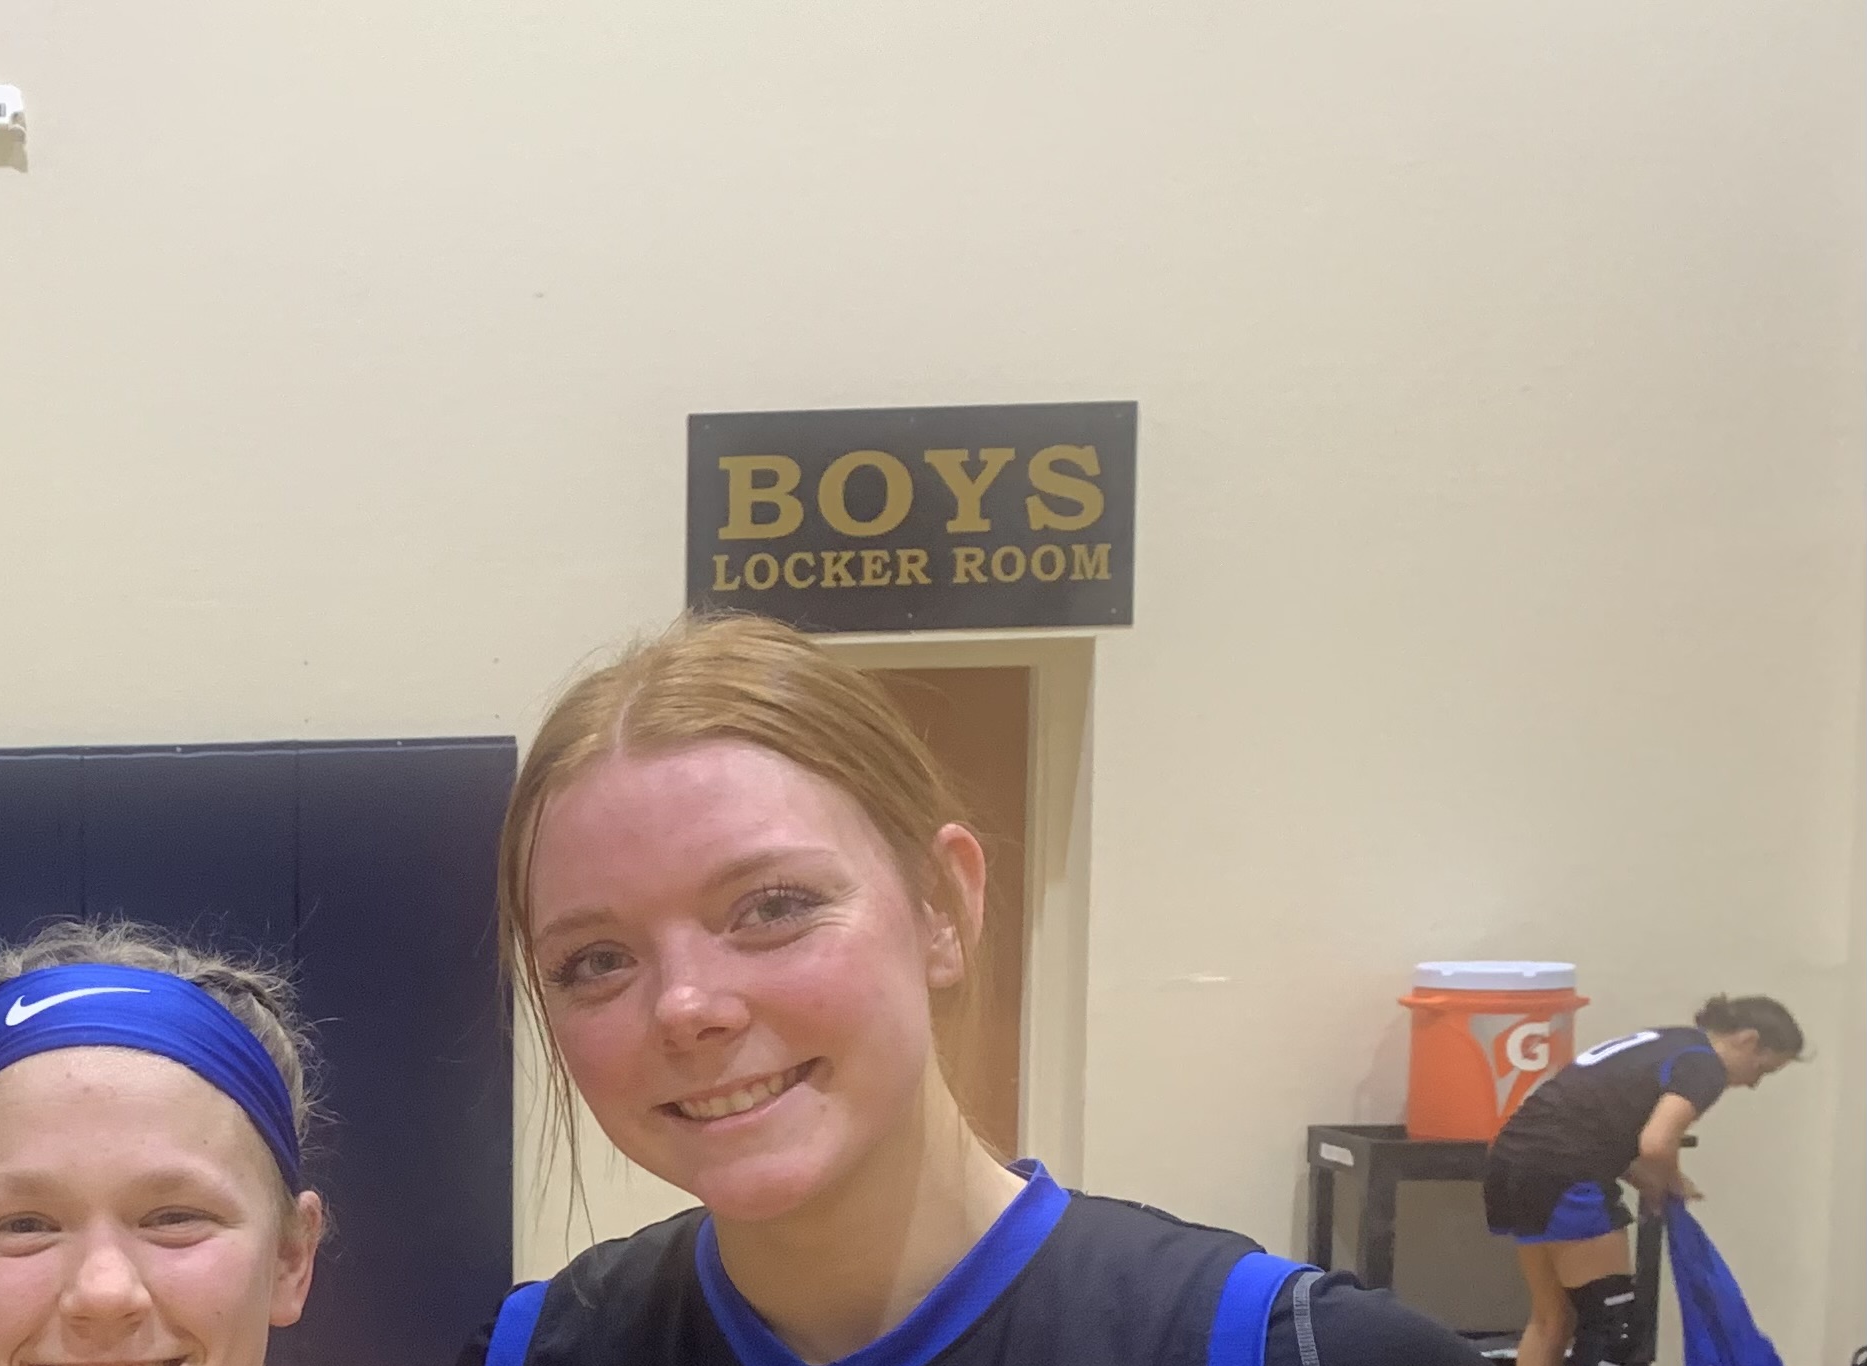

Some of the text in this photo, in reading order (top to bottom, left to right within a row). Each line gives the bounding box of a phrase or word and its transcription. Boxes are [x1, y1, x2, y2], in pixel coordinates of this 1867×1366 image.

[718, 445, 1105, 540] BOYS
[712, 543, 1112, 592] LOCKER ROOM
[1506, 1022, 1551, 1071] G
